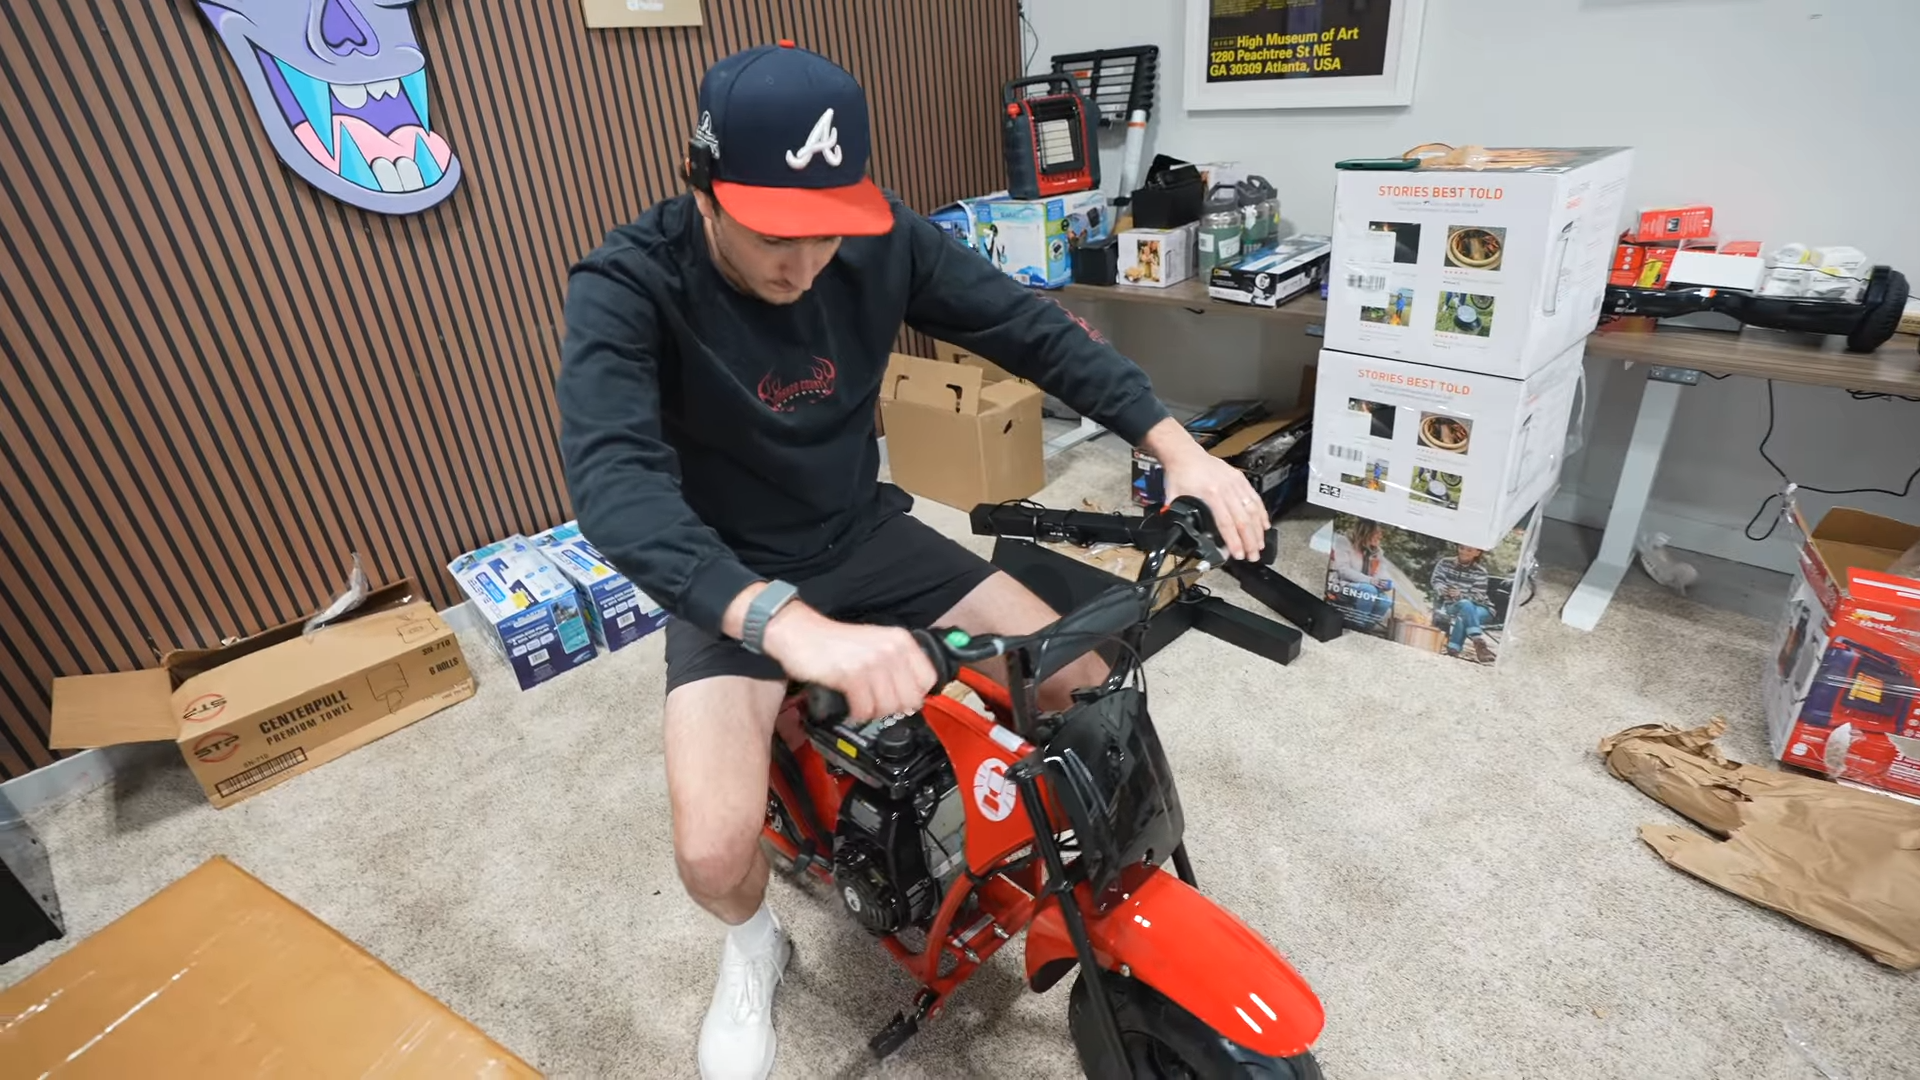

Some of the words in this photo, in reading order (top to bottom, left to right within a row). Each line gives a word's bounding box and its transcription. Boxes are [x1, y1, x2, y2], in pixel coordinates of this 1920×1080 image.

[1237, 35, 1263, 49] High
[1266, 32, 1318, 46] Museum
[1321, 28, 1336, 42] of
[1337, 27, 1359, 40] Art
[1210, 50, 1235, 63] 1280
[1237, 48, 1293, 61] Peachtree
[1296, 45, 1310, 58] St
[1313, 44, 1332, 57] NE
[1210, 64, 1227, 77] GA
[1229, 63, 1263, 76] 30309
[1264, 61, 1310, 74] Atlanta,
[1314, 57, 1341, 71] USA
[785, 107, 843, 170] A
[1378, 185, 1429, 198] STORIES
[1432, 187, 1465, 199] BEST
[1469, 188, 1504, 200] TOLD
[1358, 369, 1404, 384] STORIES
[1406, 377, 1436, 390] BEST
[1440, 381, 1470, 395] TOLD
[1327, 582, 1340, 593] TO
[1342, 587, 1377, 602] ENJOY
[429, 666, 436, 675] 6
[436, 657, 459, 673] ROLLS
[258, 690, 348, 735] CENTERPULL
[265, 718, 318, 746] PREMIUM
[319, 702, 354, 724] TOWEL
[194, 734, 239, 759] STP
